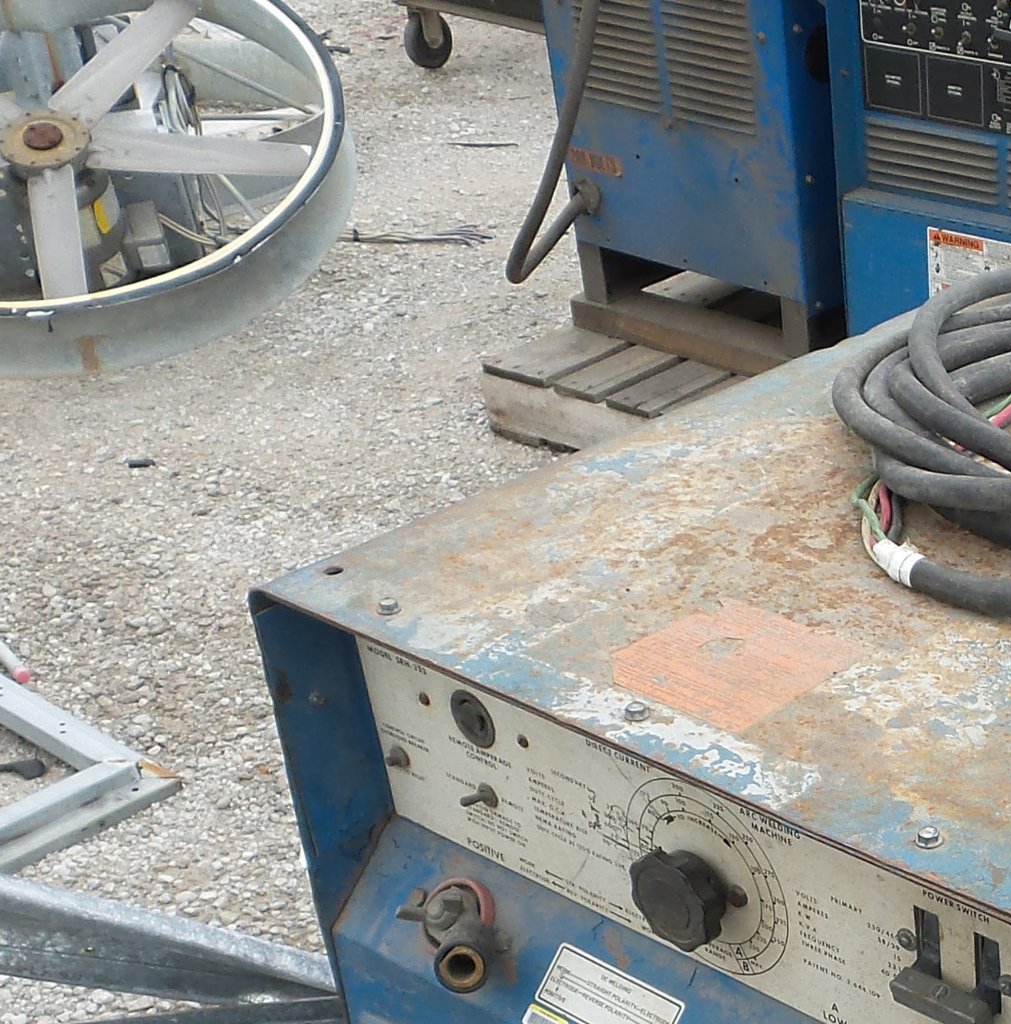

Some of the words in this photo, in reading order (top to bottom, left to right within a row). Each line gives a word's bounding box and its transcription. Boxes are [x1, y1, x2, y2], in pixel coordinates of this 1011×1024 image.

[942, 233, 980, 249] WARNING
[465, 750, 497, 771] CONTROL
[614, 752, 651, 774] CURRENT
[739, 808, 757, 820] ARC
[760, 815, 801, 840] WELDING
[751, 822, 793, 847] MACHINE
[466, 835, 505, 863] POSITIVE
[795, 890, 818, 904] VOLTS
[866, 922, 896, 939] 230/46
[797, 900, 829, 920] AMPERES
[830, 895, 862, 914] PRIMARY
[922, 889, 954, 909] POWER
[956, 902, 990, 925] SWITCH
[735, 946, 743, 957] A
[799, 930, 841, 953] FREQUENCY
[801, 940, 822, 954] THREE
[823, 951, 846, 965] PHASE
[742, 960, 750, 972] B
[803, 958, 829, 975] PATENT
[831, 1002, 839, 1013] A
